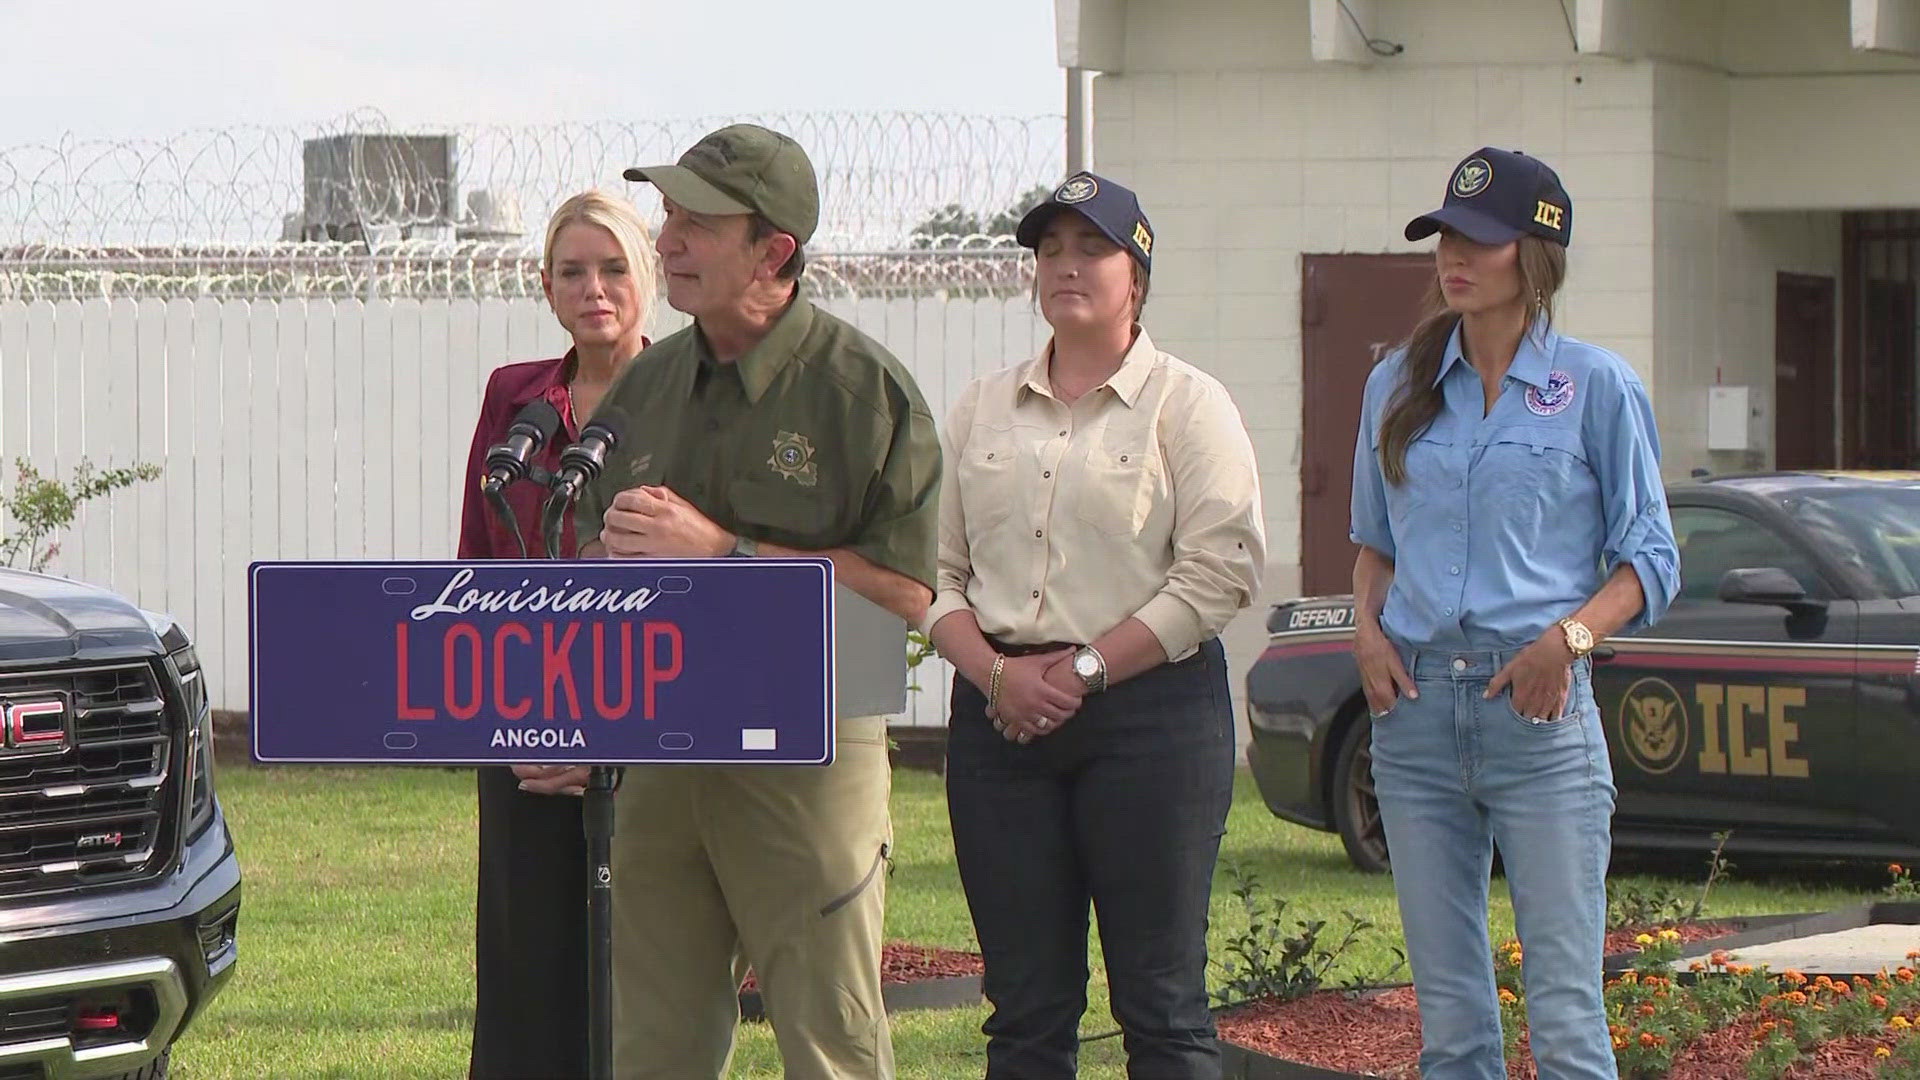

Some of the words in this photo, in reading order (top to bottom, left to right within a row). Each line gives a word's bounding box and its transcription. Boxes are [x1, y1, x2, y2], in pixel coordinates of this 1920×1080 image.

[1534, 200, 1564, 231] ICE
[410, 568, 661, 621] Louisiana
[1289, 608, 1347, 629] DEFEND
[396, 621, 684, 721] LOCKUP
[490, 728, 587, 748] ANGOLA
[1695, 682, 1810, 778] ICE
